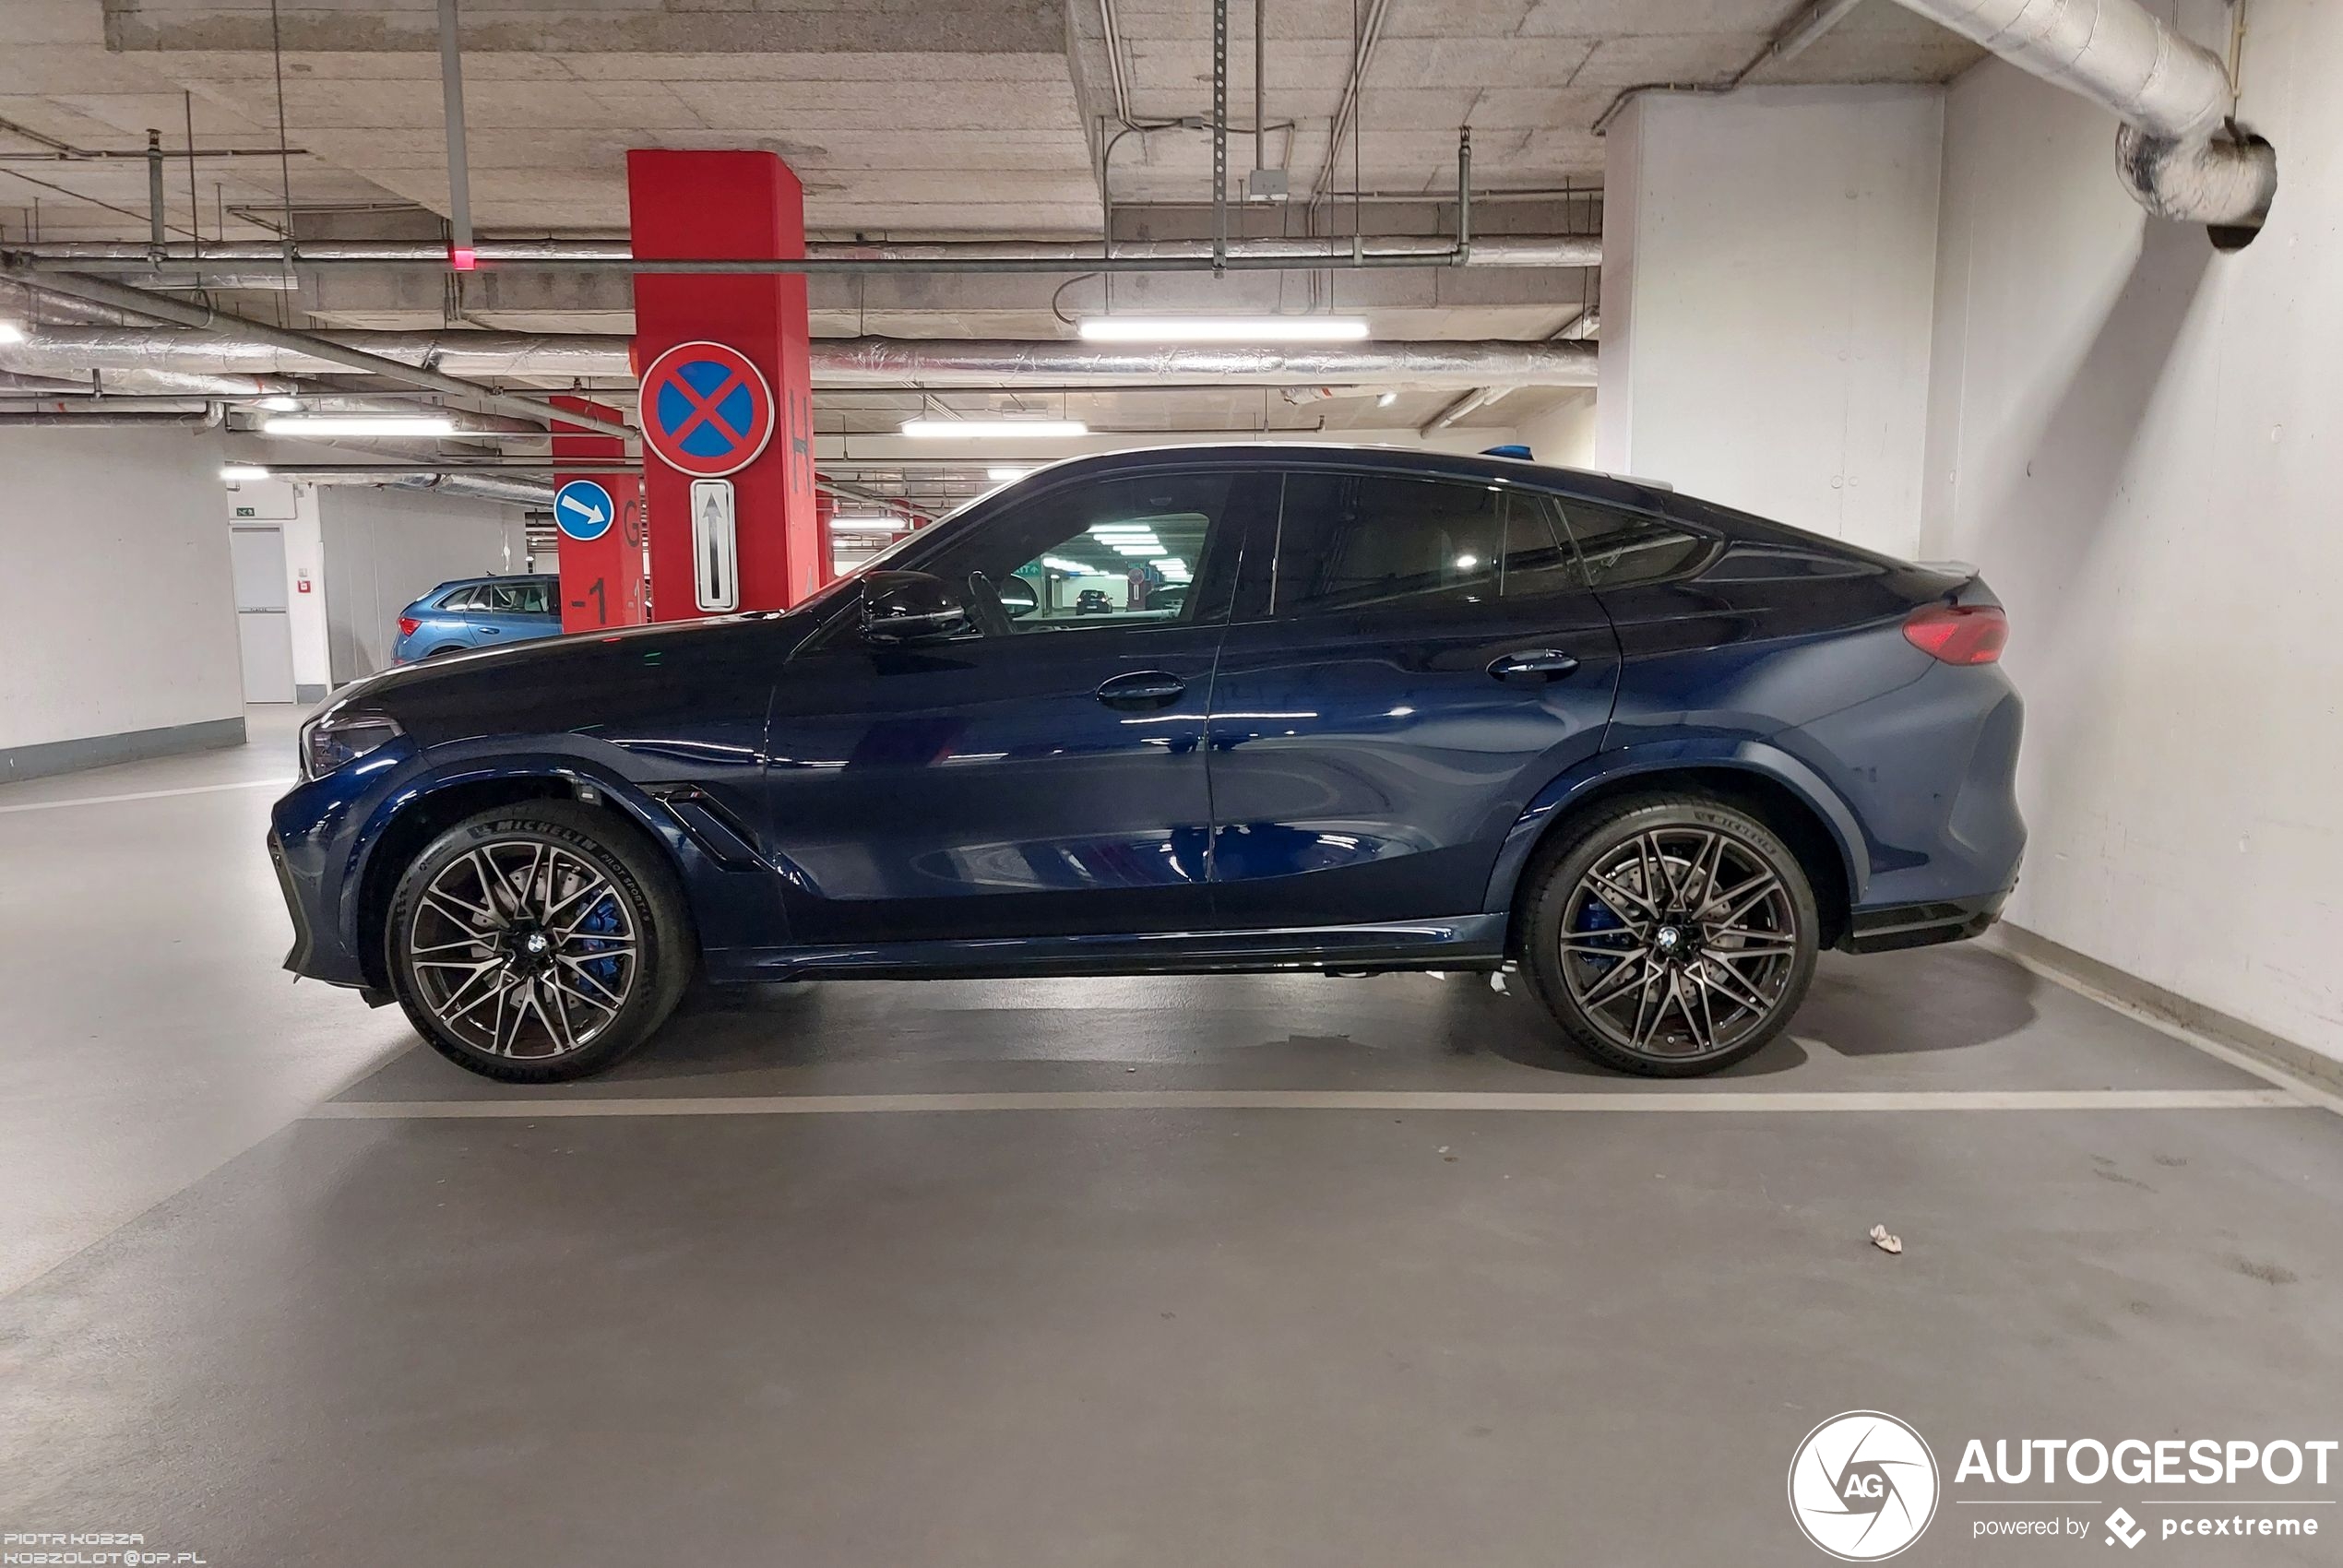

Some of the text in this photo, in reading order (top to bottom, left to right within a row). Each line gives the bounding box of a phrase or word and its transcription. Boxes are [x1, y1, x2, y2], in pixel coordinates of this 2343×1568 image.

[624, 500, 640, 548] G
[571, 577, 606, 624] -1
[496, 820, 598, 851] MICHELIN
[601, 853, 626, 875] PILOT
[624, 877, 646, 909] SPORT
